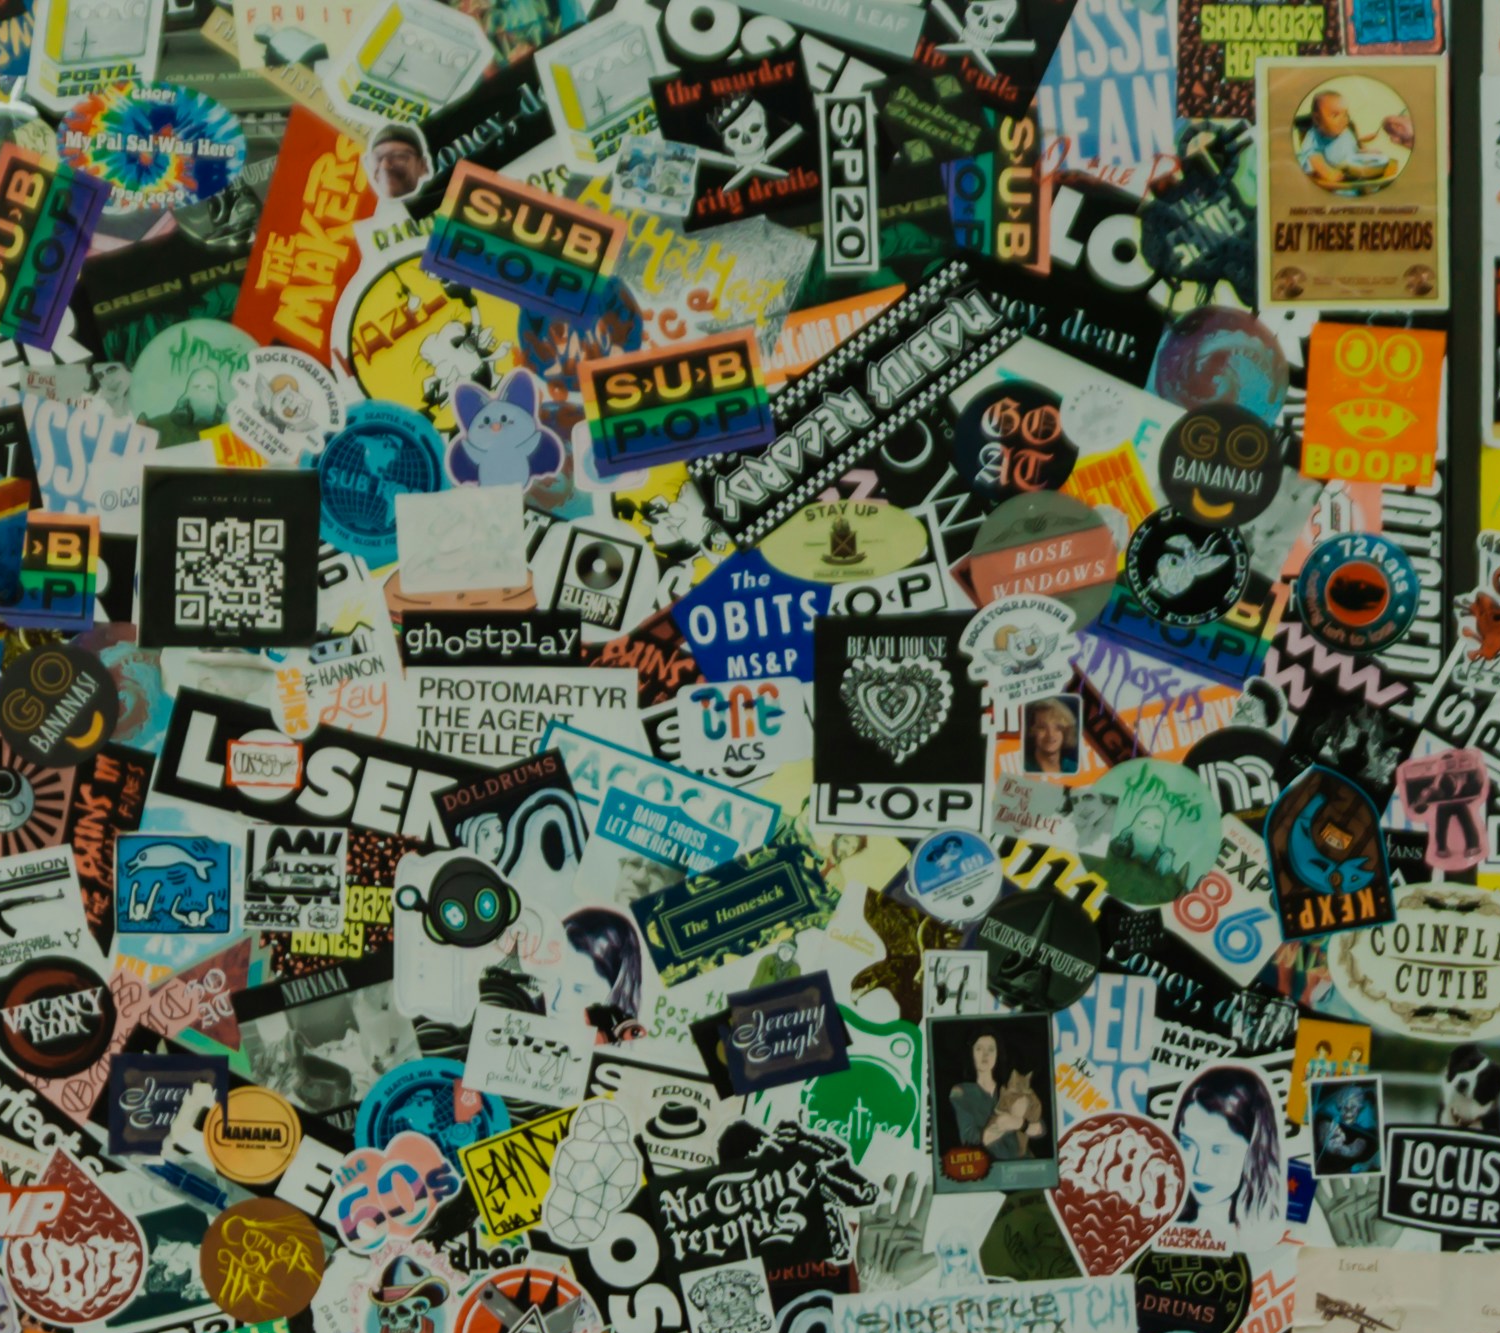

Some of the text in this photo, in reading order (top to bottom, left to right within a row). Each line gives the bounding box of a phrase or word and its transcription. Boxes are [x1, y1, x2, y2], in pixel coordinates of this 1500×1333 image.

[65, 131, 236, 157] My Pal Sal Was Here
[1275, 221, 1433, 252] EAT THESE RECORDS
[803, 501, 880, 522] STAY UP
[406, 624, 577, 657] ghostplay
[419, 677, 627, 708] PROTOMARTYR
[418, 708, 574, 732] THE AGENT
[7, 857, 68, 878] VISION
[681, 883, 785, 940] The Homesick
[984, 921, 1093, 982] KING TUFF
[1396, 963, 1489, 999] CUTIE
[1410, 1197, 1500, 1223] CIDER
